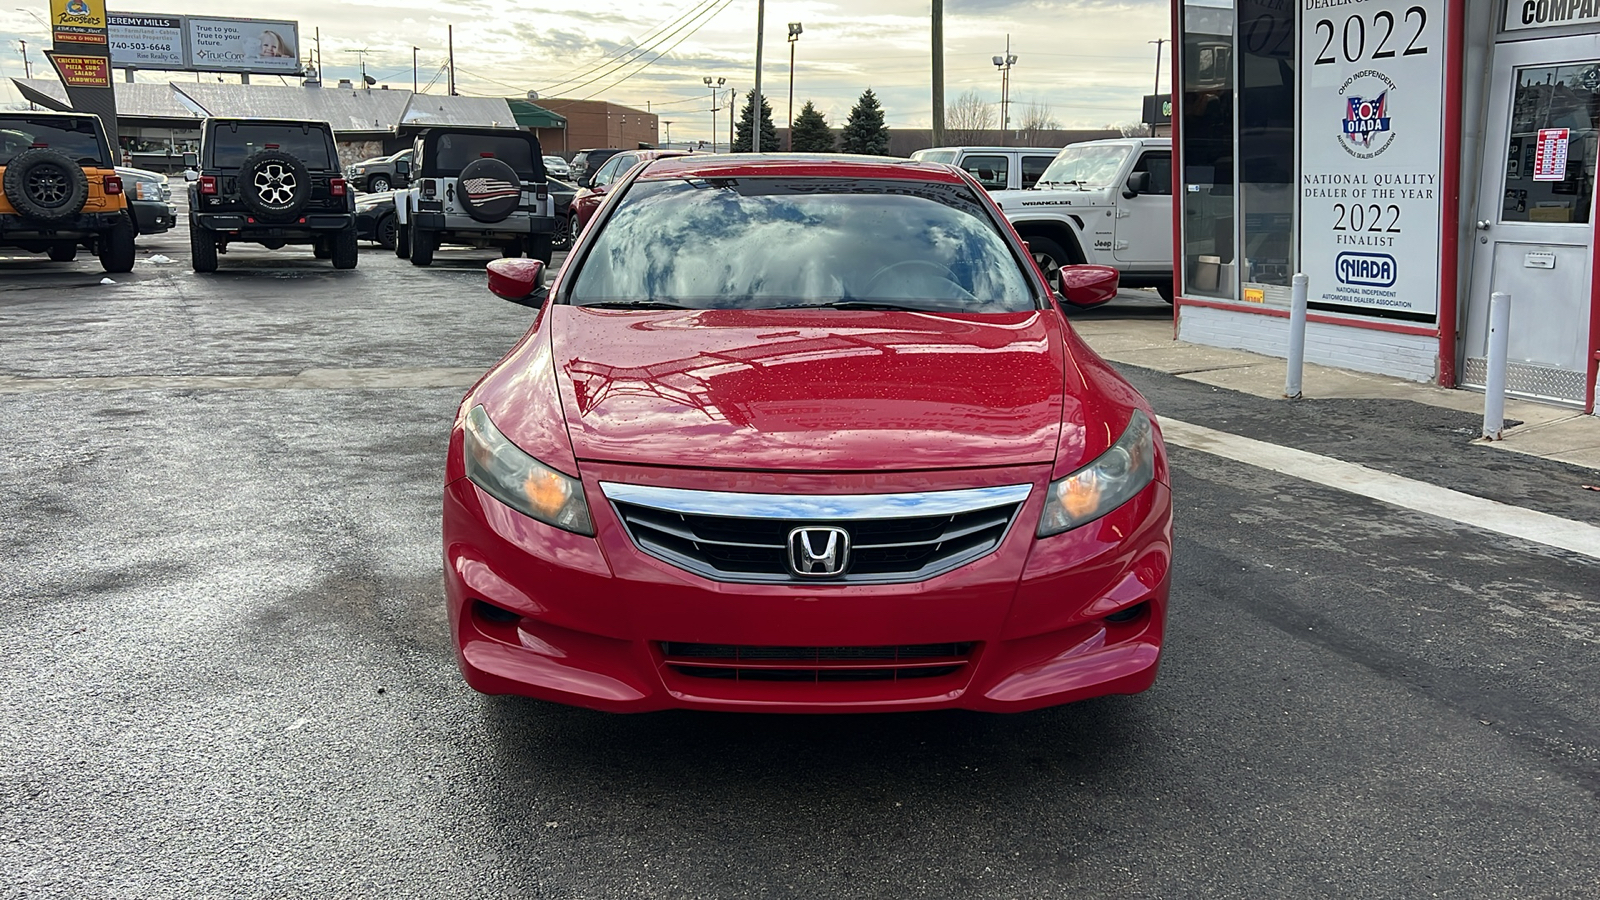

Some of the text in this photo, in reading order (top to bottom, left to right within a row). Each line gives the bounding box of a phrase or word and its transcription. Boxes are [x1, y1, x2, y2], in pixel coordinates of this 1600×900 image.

[58, 12, 100, 25] Roosters
[108, 17, 142, 26] JEREMY
[1314, 6, 1428, 65] 2022
[111, 42, 171, 51] 740-503-6648
[151, 53, 168, 61] Realty
[1338, 70, 1397, 95] OHIO INDEPENDENT
[1348, 119, 1382, 132] OIADA
[1337, 135, 1356, 157] AUTOMOBILE
[1374, 132, 1396, 157] ASSOCIATION
[1304, 174, 1435, 186] NATIONAL QUALITY
[1305, 188, 1433, 199] DEALER OF THE YEAR
[1332, 204, 1400, 233] 2022
[1094, 240, 1112, 248] Jeep
[1337, 235, 1394, 246] FINALIST
[1340, 259, 1390, 280] NIADA
[1362, 289, 1396, 297] INDEPENDENT
[1322, 294, 1352, 302] AUTOMOBILE
[1376, 299, 1412, 308] ASSOCIATION
